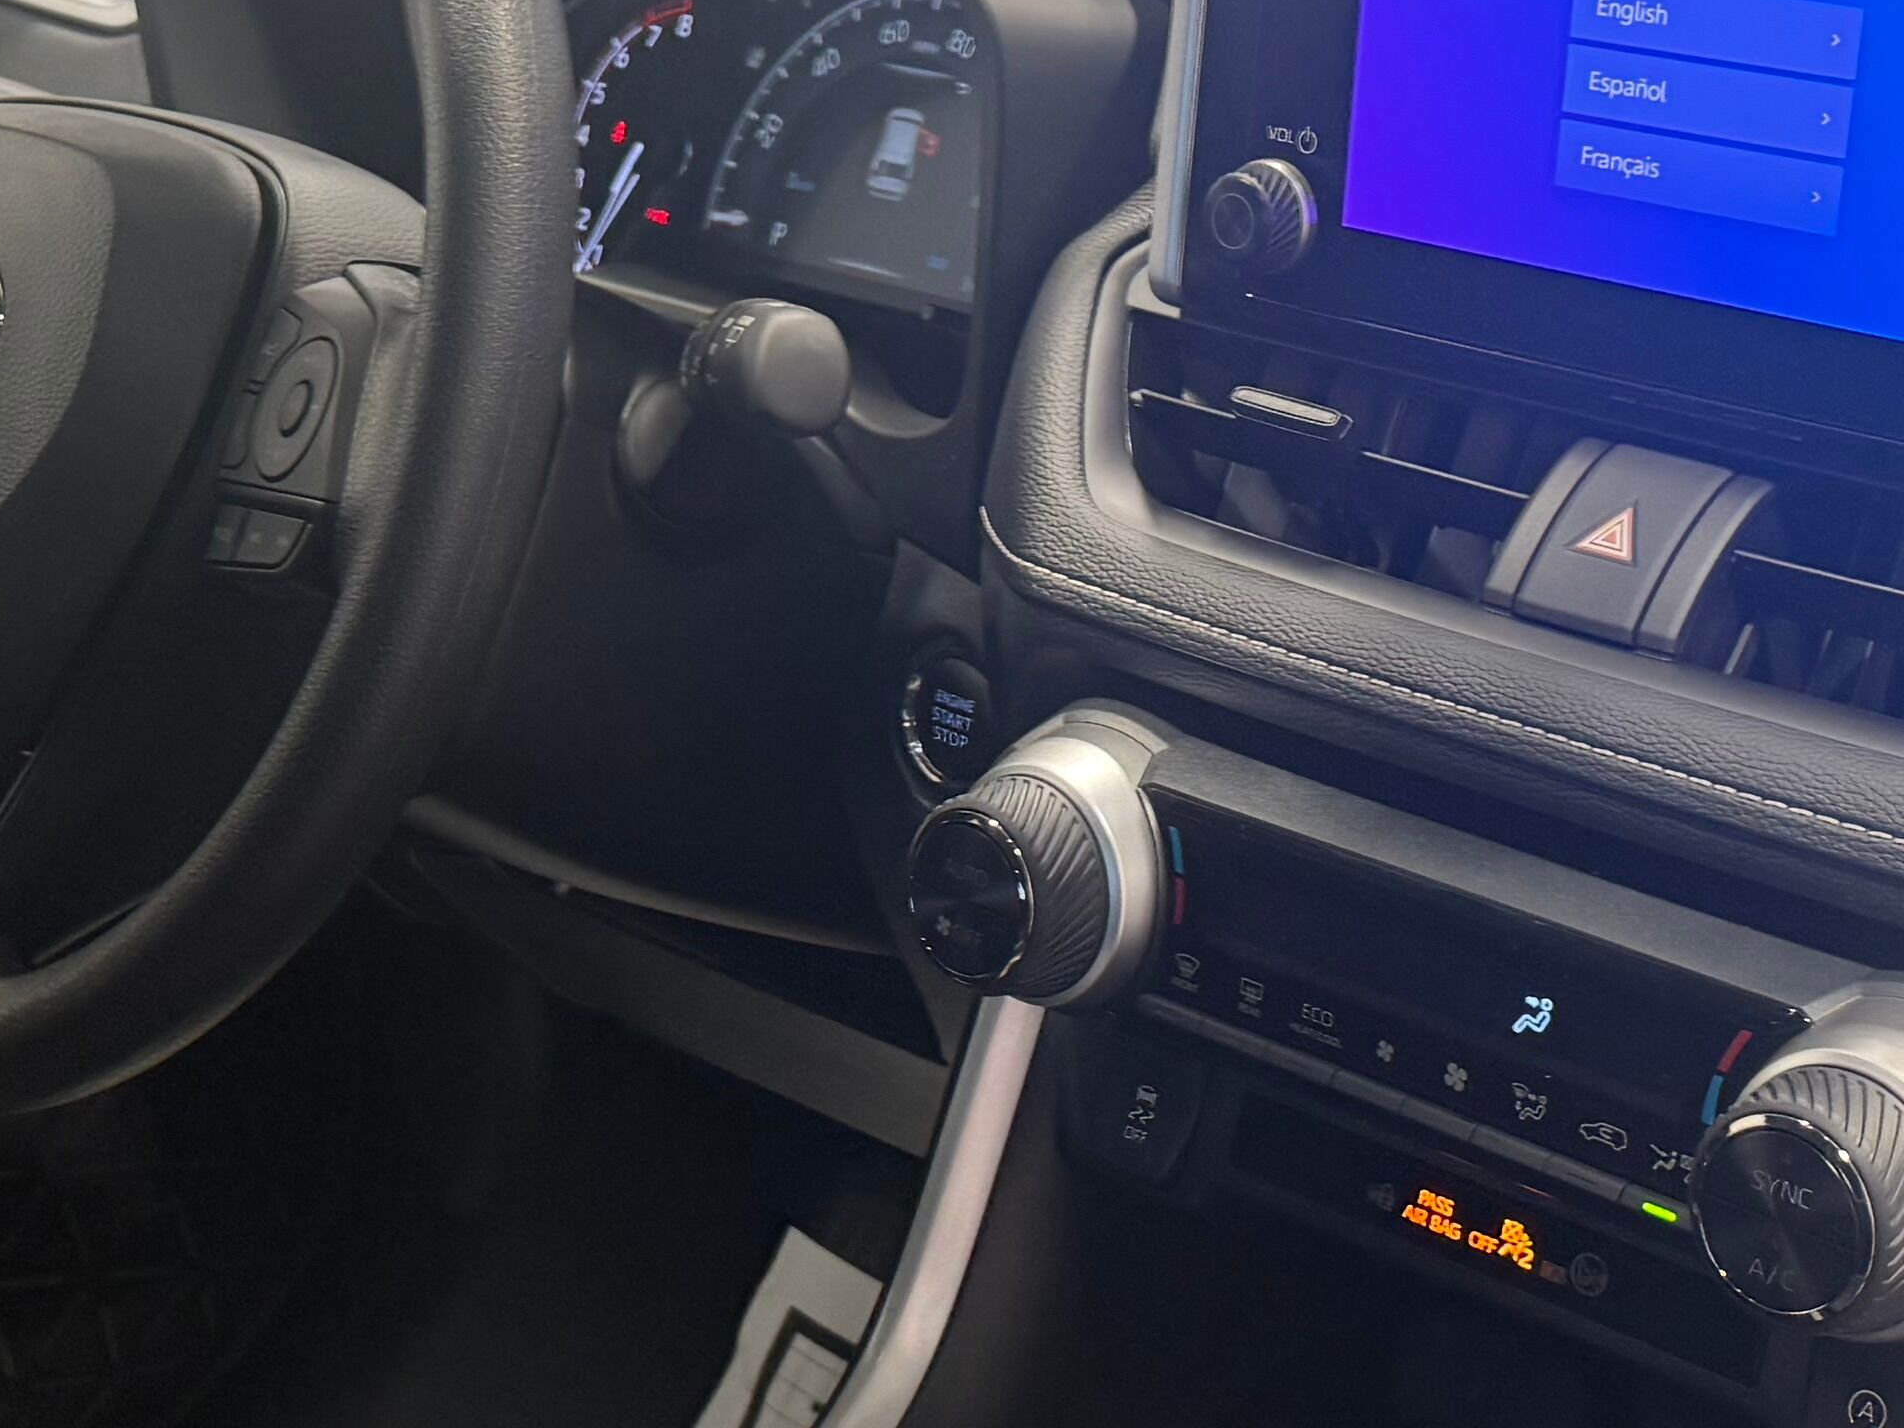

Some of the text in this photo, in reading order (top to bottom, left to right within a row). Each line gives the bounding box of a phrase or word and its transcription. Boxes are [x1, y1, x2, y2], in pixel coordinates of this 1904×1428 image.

[645, 25, 663, 48] 7
[676, 14, 694, 39] 8
[948, 29, 977, 59] 80
[1589, 71, 1668, 103] Español
[1267, 125, 1294, 145] VOL
[1580, 146, 1661, 179] Français
[932, 725, 969, 748] STOP
[1301, 1003, 1334, 1027] ECO
[1417, 1189, 1455, 1217] PASS
[1750, 1170, 1814, 1211] SYNC
[1428, 1214, 1462, 1241] BAG
[1467, 1230, 1500, 1254] OFF
[1748, 1258, 1794, 1292] A/C
